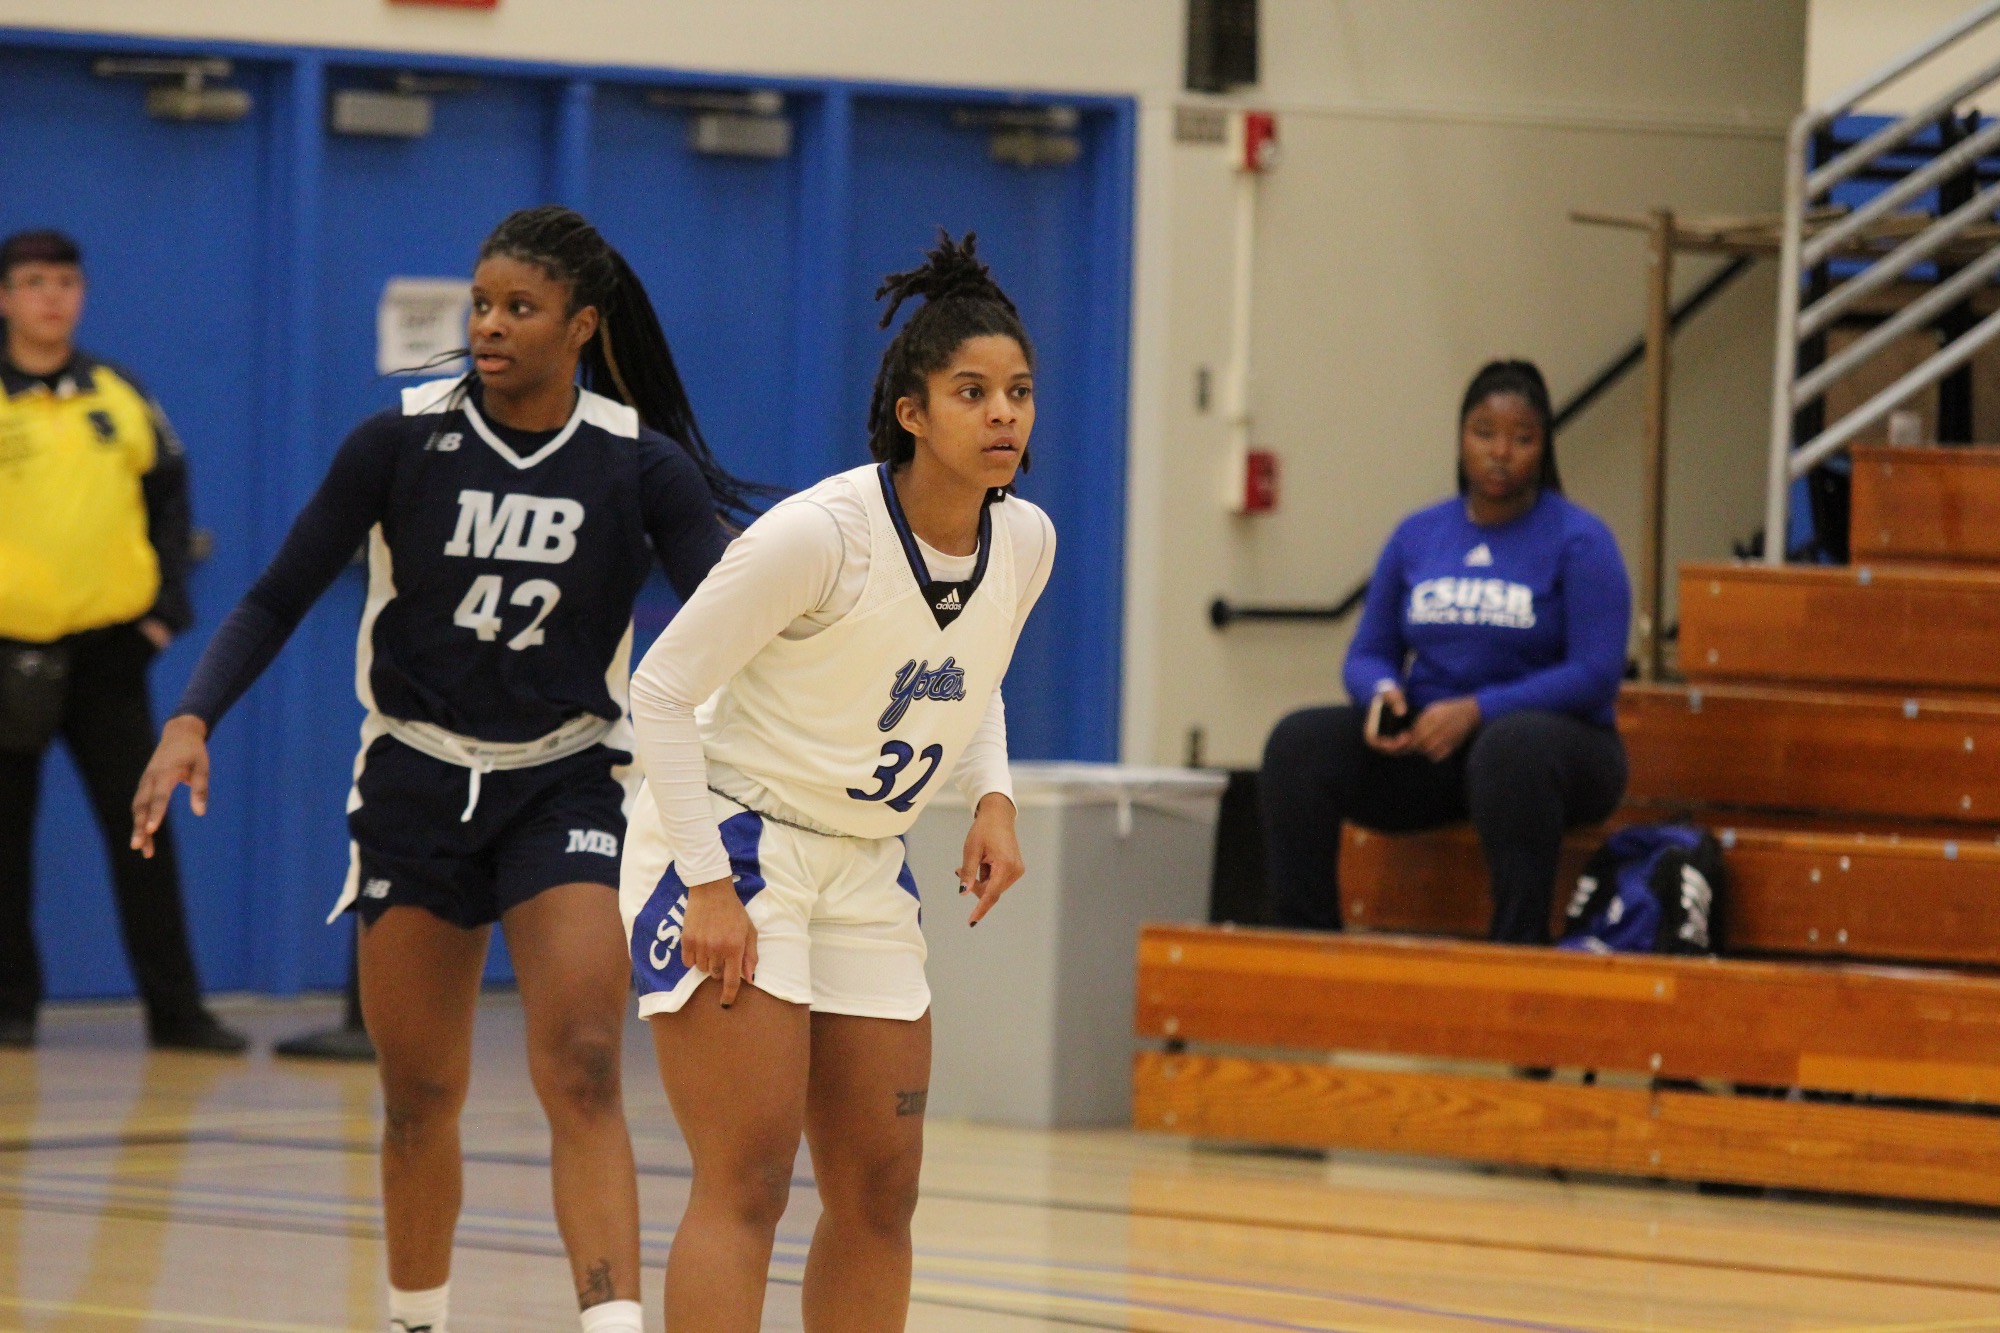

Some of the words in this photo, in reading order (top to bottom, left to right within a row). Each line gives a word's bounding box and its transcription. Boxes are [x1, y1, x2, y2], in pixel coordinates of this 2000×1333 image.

[443, 489, 586, 564] MB
[453, 574, 562, 651] 42
[935, 601, 962, 610] adidas
[877, 656, 967, 732] Yotes
[845, 739, 944, 813] 32
[565, 829, 619, 857] MB
